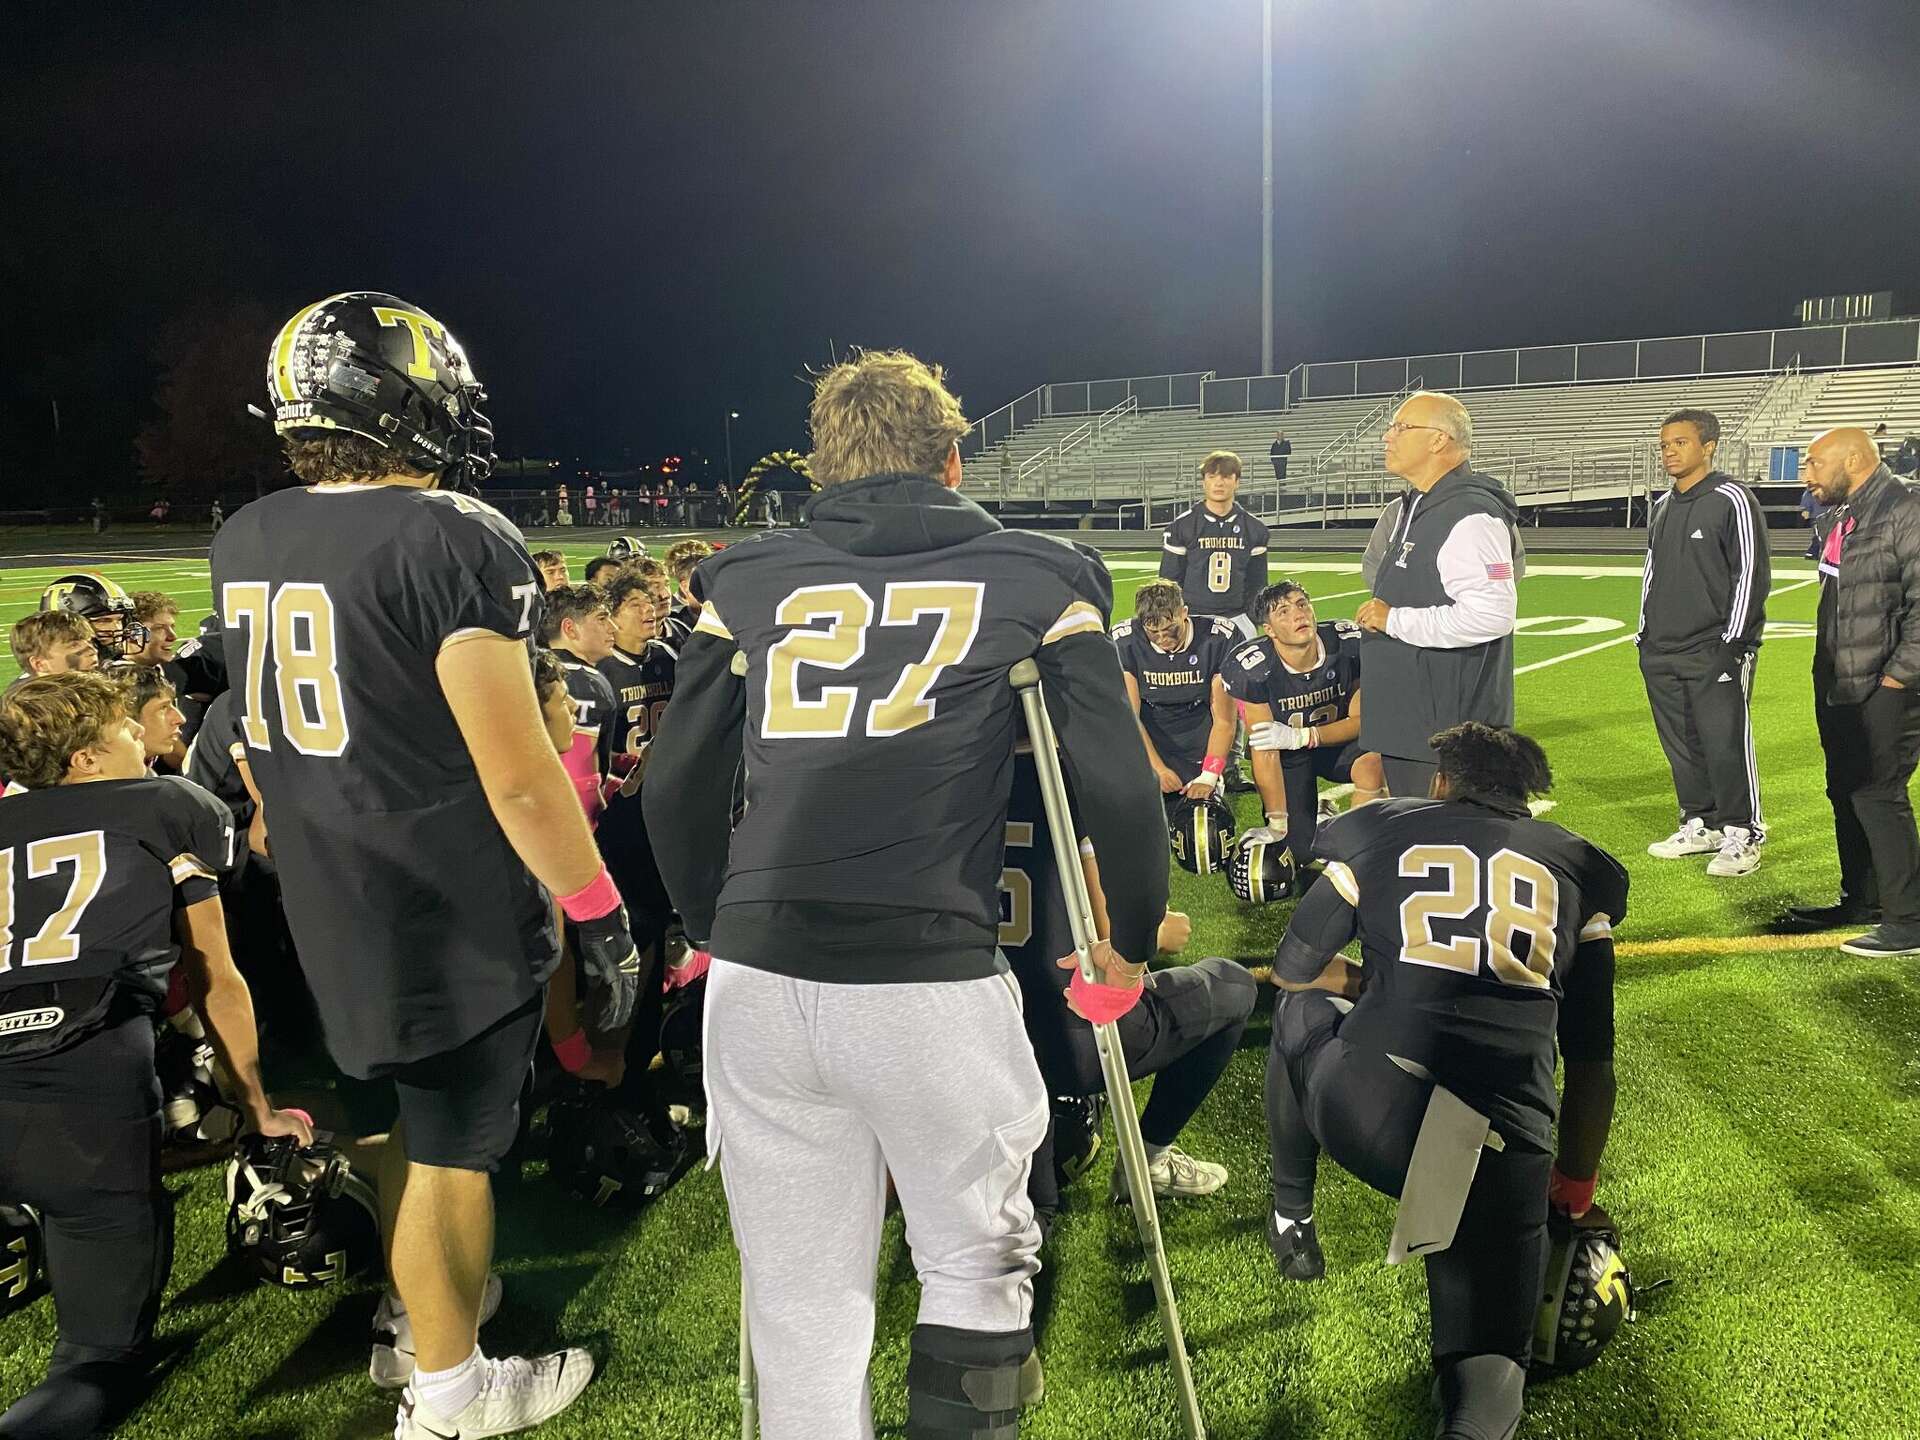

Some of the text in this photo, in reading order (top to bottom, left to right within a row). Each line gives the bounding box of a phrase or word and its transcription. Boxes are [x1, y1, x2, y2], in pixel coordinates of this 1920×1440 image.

[371, 306, 443, 382] T
[1198, 537, 1245, 550] TRUMBULL
[1208, 551, 1232, 593] 8
[222, 581, 349, 757] 78
[761, 582, 986, 739] 27
[1143, 669, 1205, 687] TRUMBULL
[1278, 683, 1346, 712] TRUMBULL
[1398, 844, 1559, 990] 28
